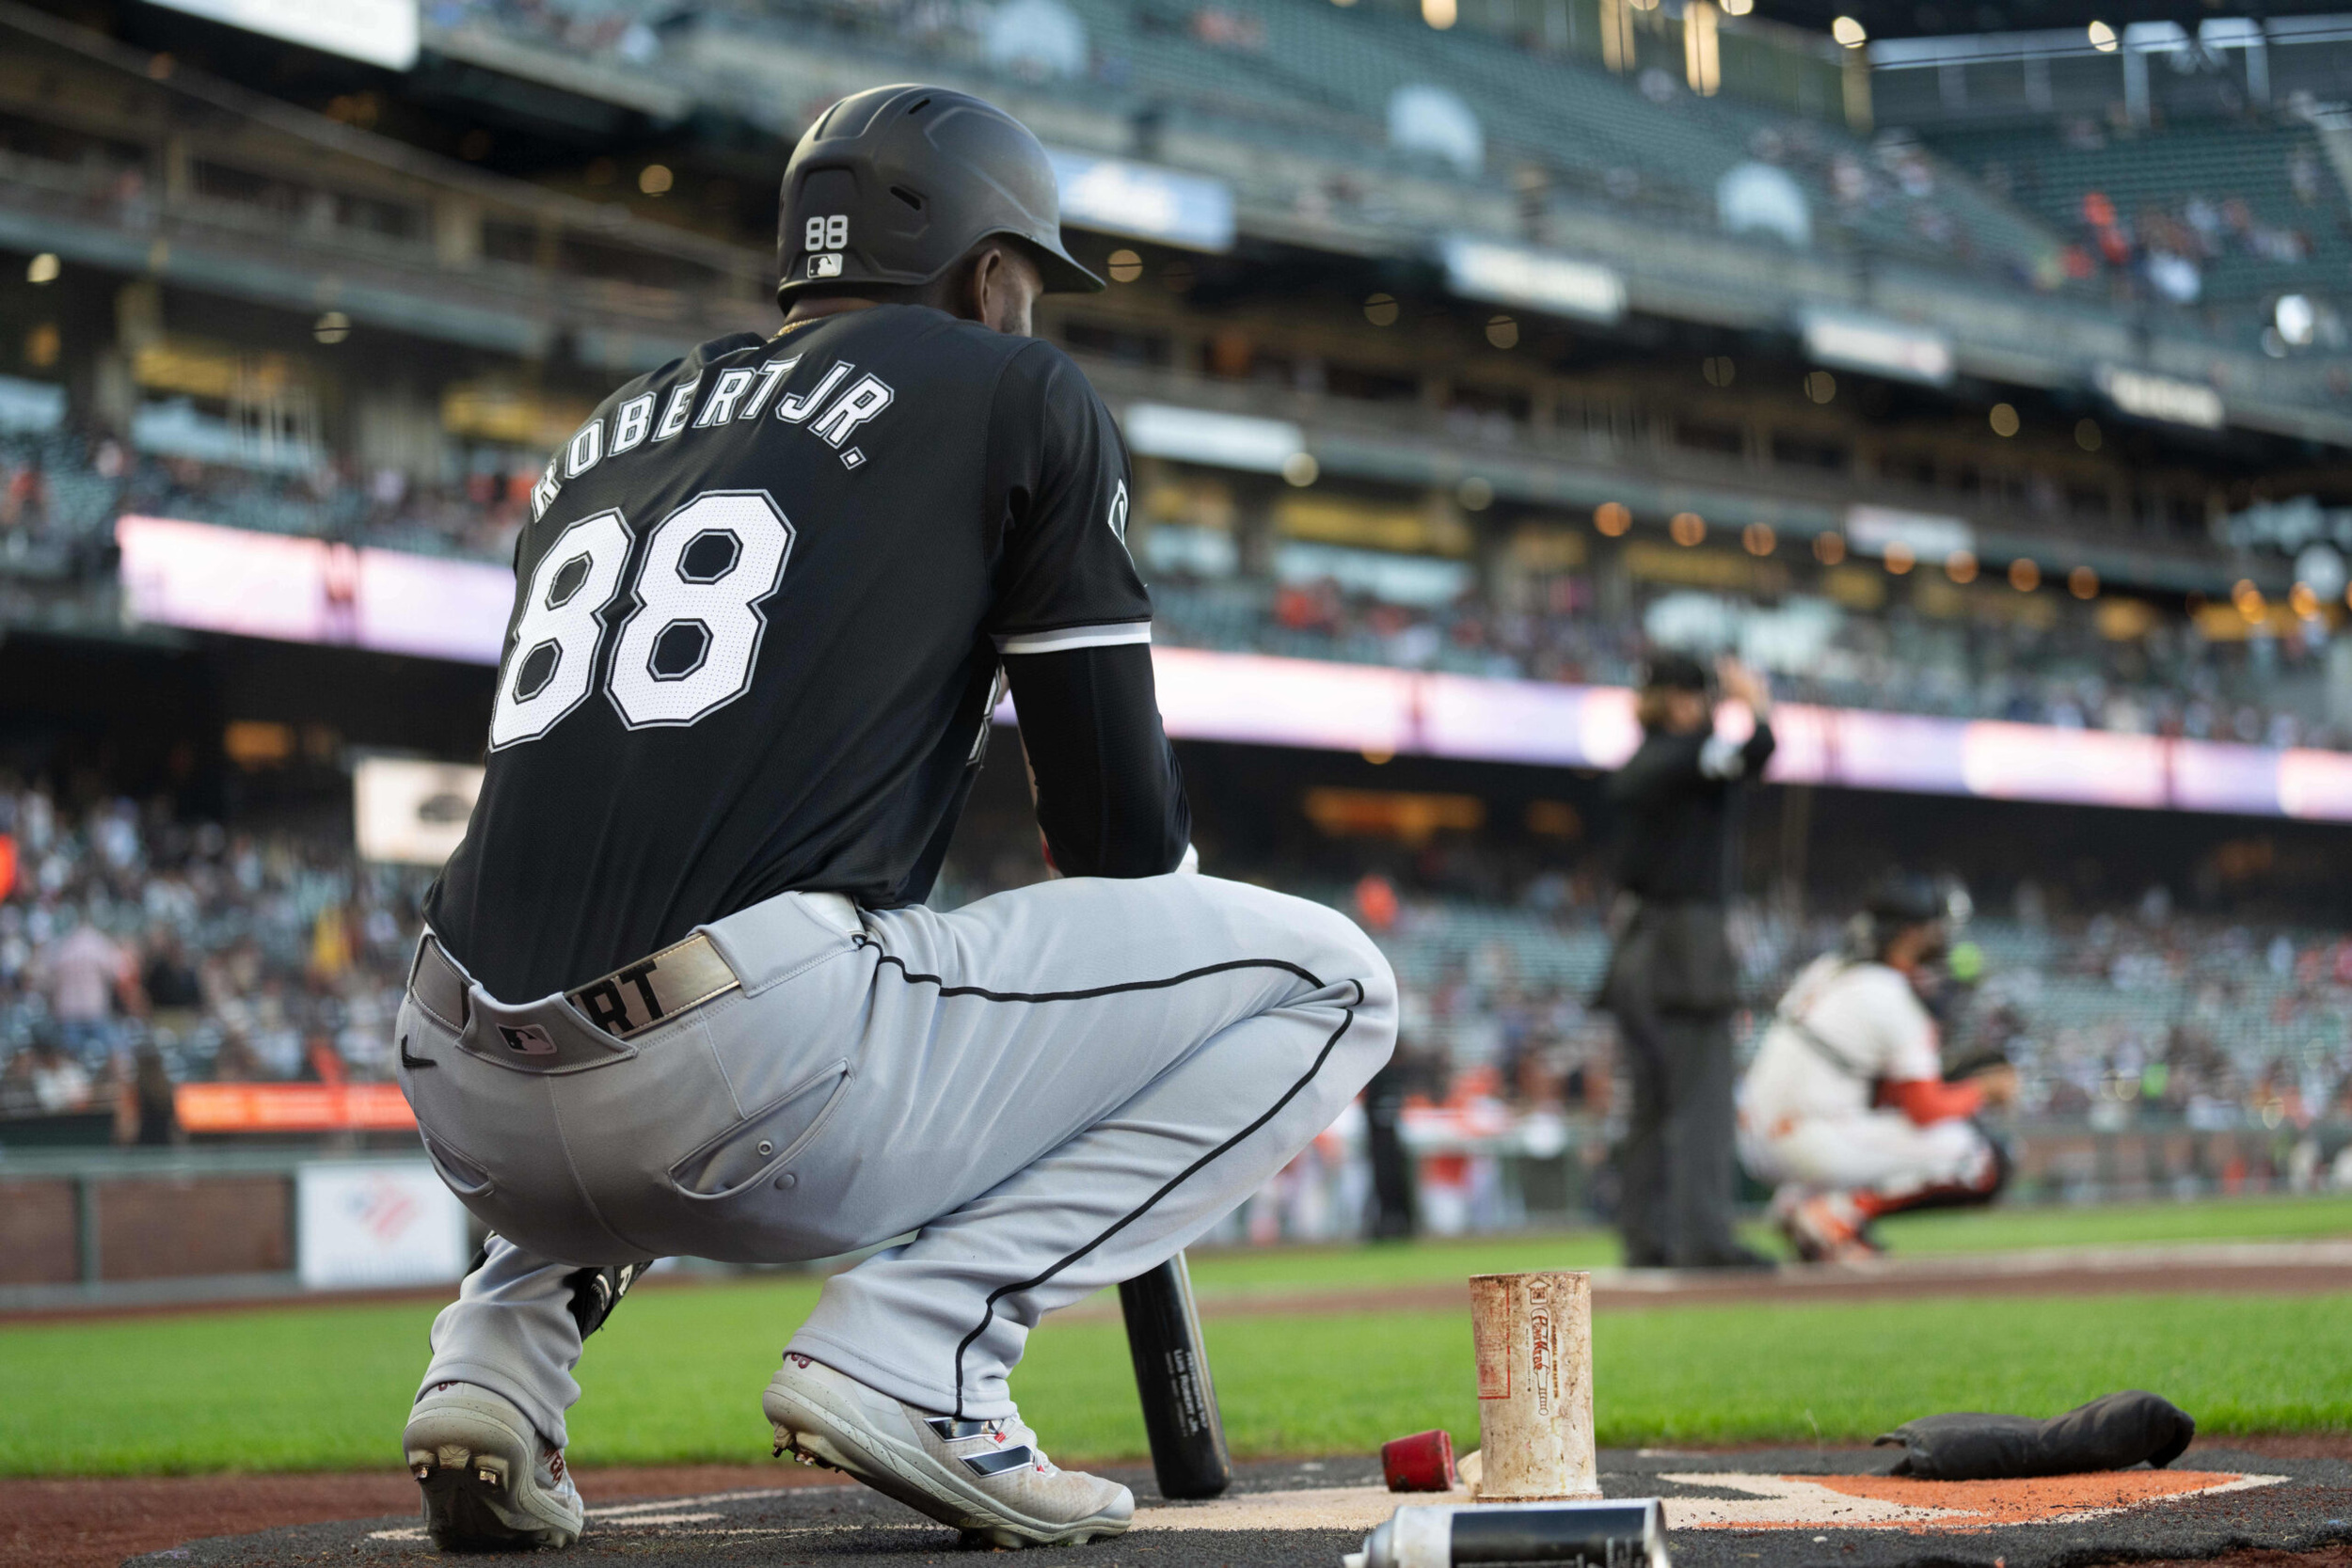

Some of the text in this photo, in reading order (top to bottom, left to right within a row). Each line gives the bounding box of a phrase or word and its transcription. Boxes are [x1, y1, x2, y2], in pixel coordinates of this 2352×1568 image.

[805, 214, 849, 251] 88
[531, 354, 803, 523] ROBERT
[488, 488, 796, 753] 88
[566, 958, 664, 1035] RT
